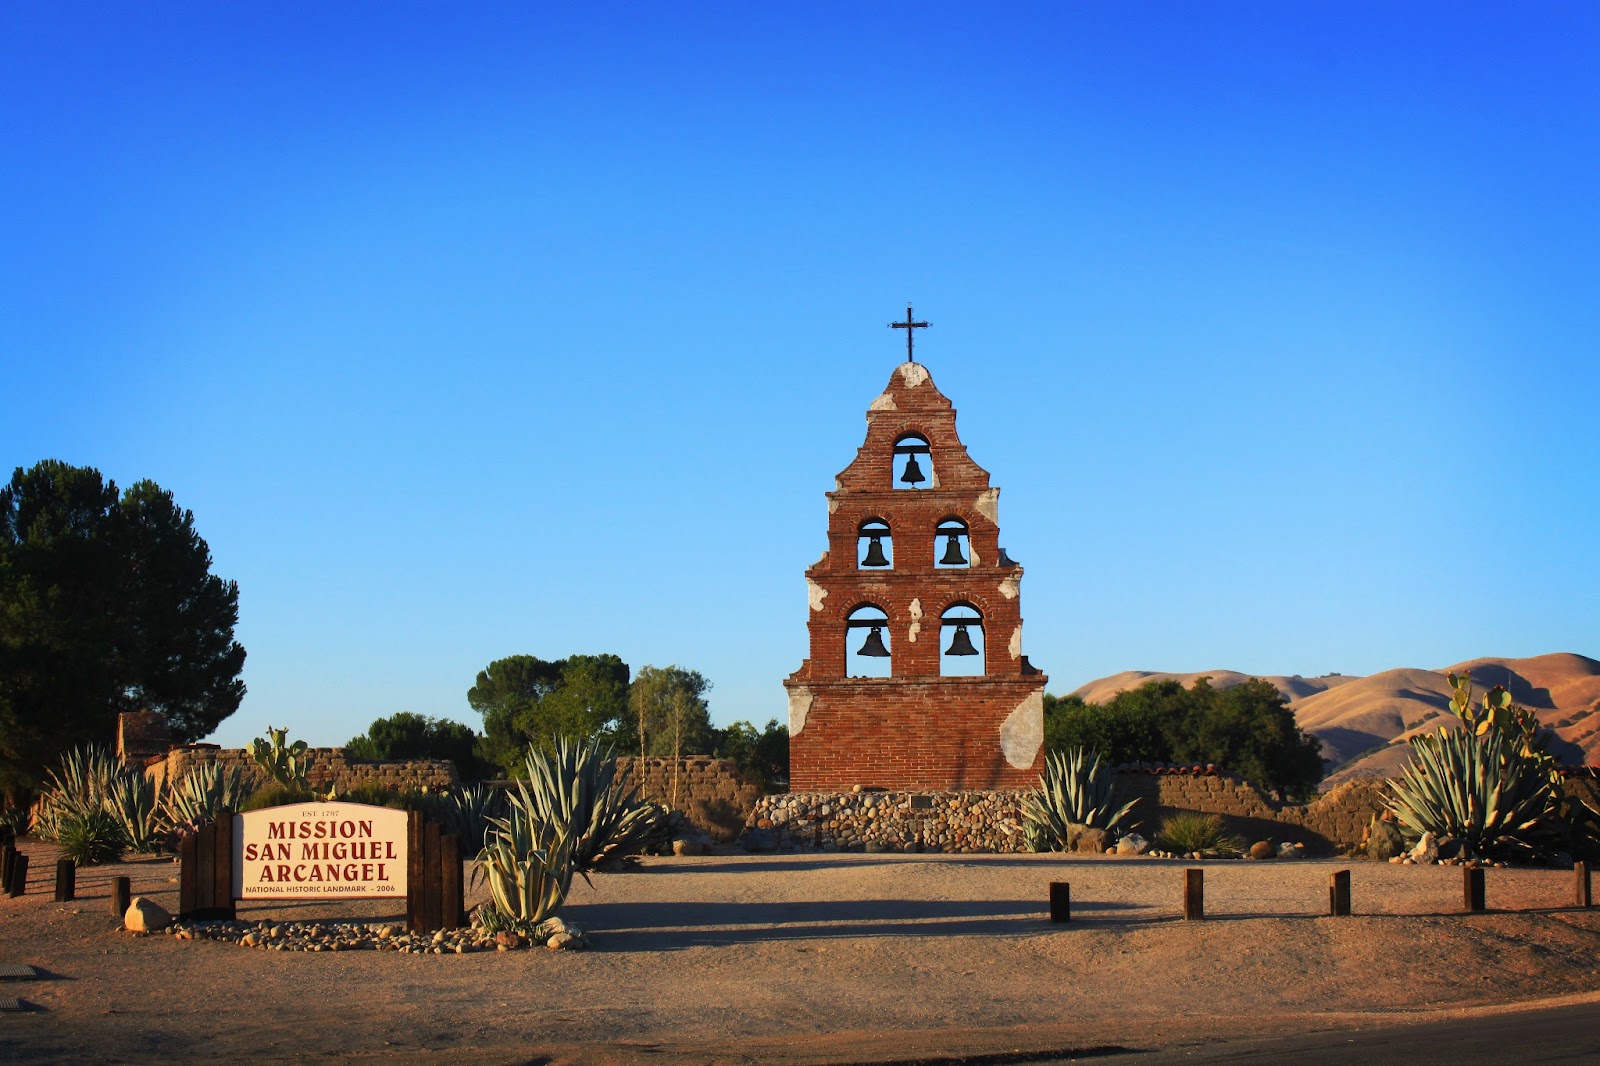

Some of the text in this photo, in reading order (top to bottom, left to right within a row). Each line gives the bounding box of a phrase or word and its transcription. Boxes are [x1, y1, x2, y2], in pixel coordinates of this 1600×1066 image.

[268, 820, 373, 839] MISSION
[245, 841, 398, 861] SAN MIGUEL
[259, 863, 389, 883] ARCANGEL
